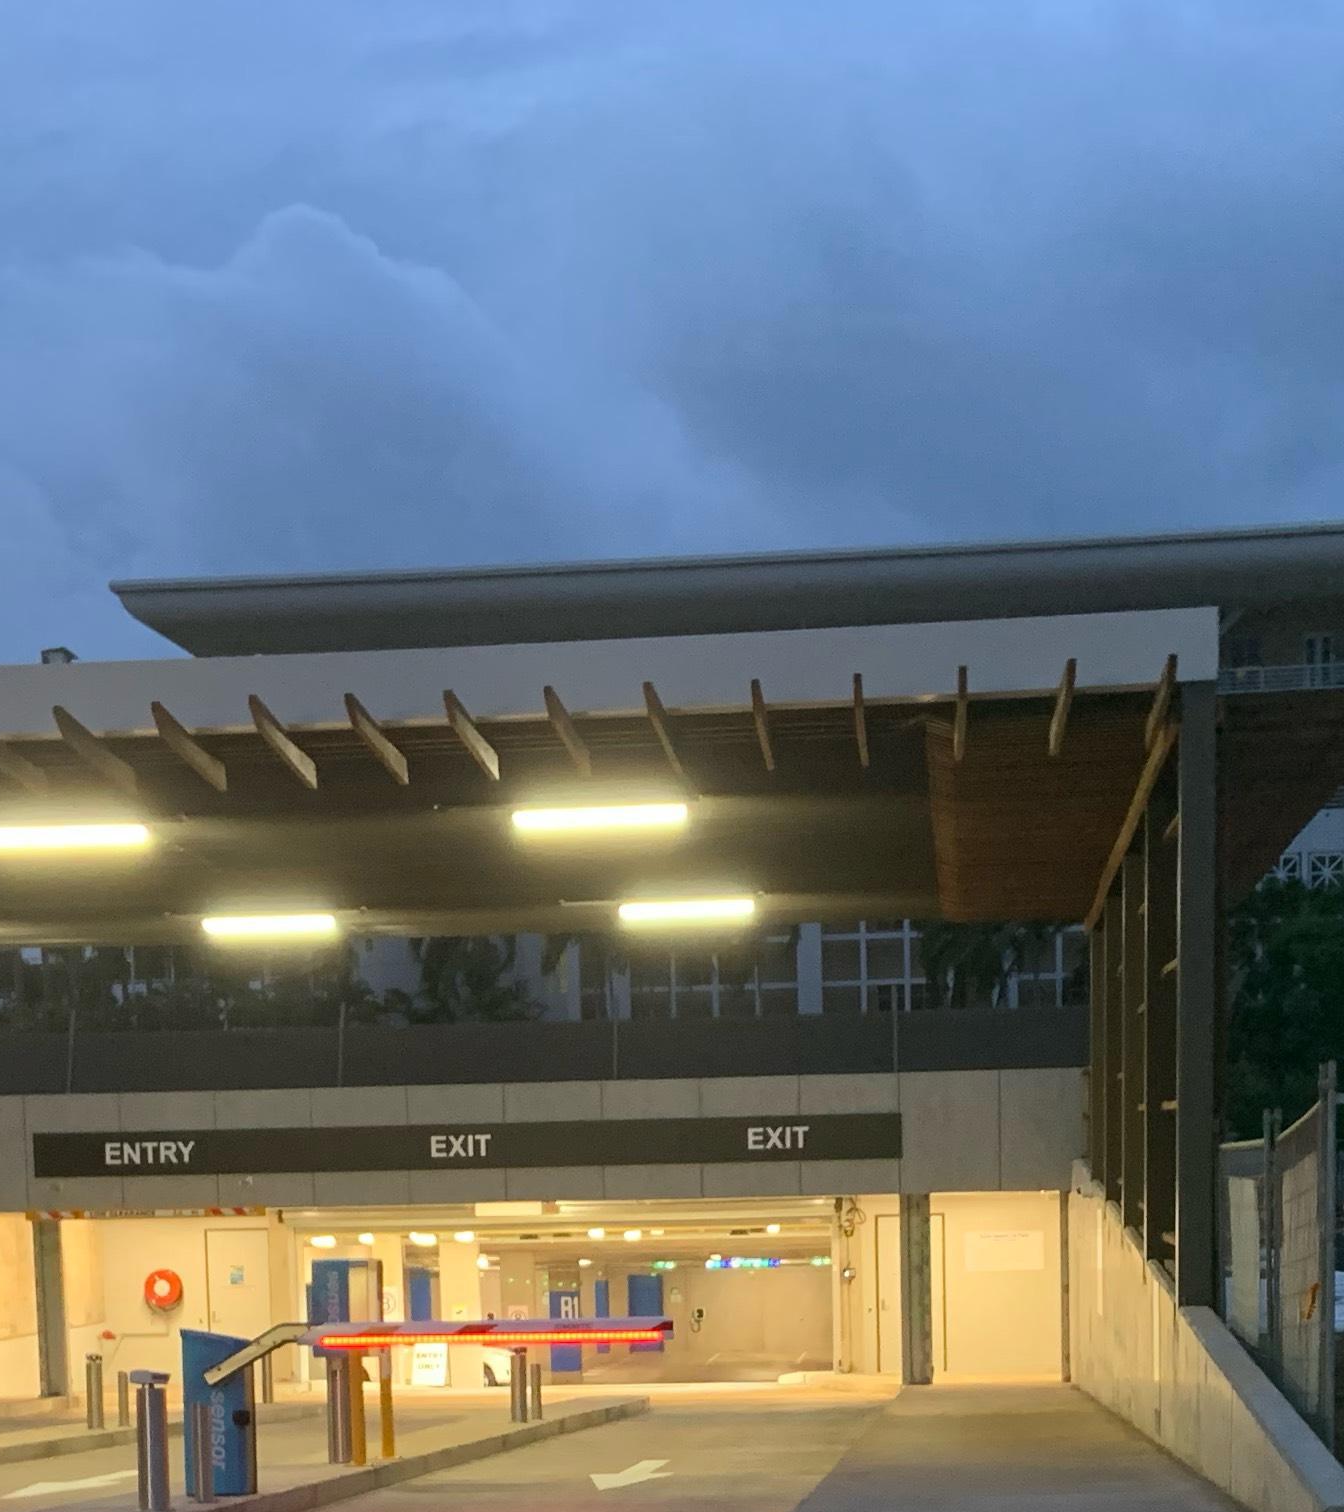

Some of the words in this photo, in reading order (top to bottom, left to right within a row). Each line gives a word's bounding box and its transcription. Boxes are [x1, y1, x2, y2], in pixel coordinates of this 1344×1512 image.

[429, 1133, 492, 1160] EXIT
[746, 1126, 810, 1152] EXIT
[104, 1140, 196, 1166] ENTRY
[210, 1390, 226, 1471] sensor
